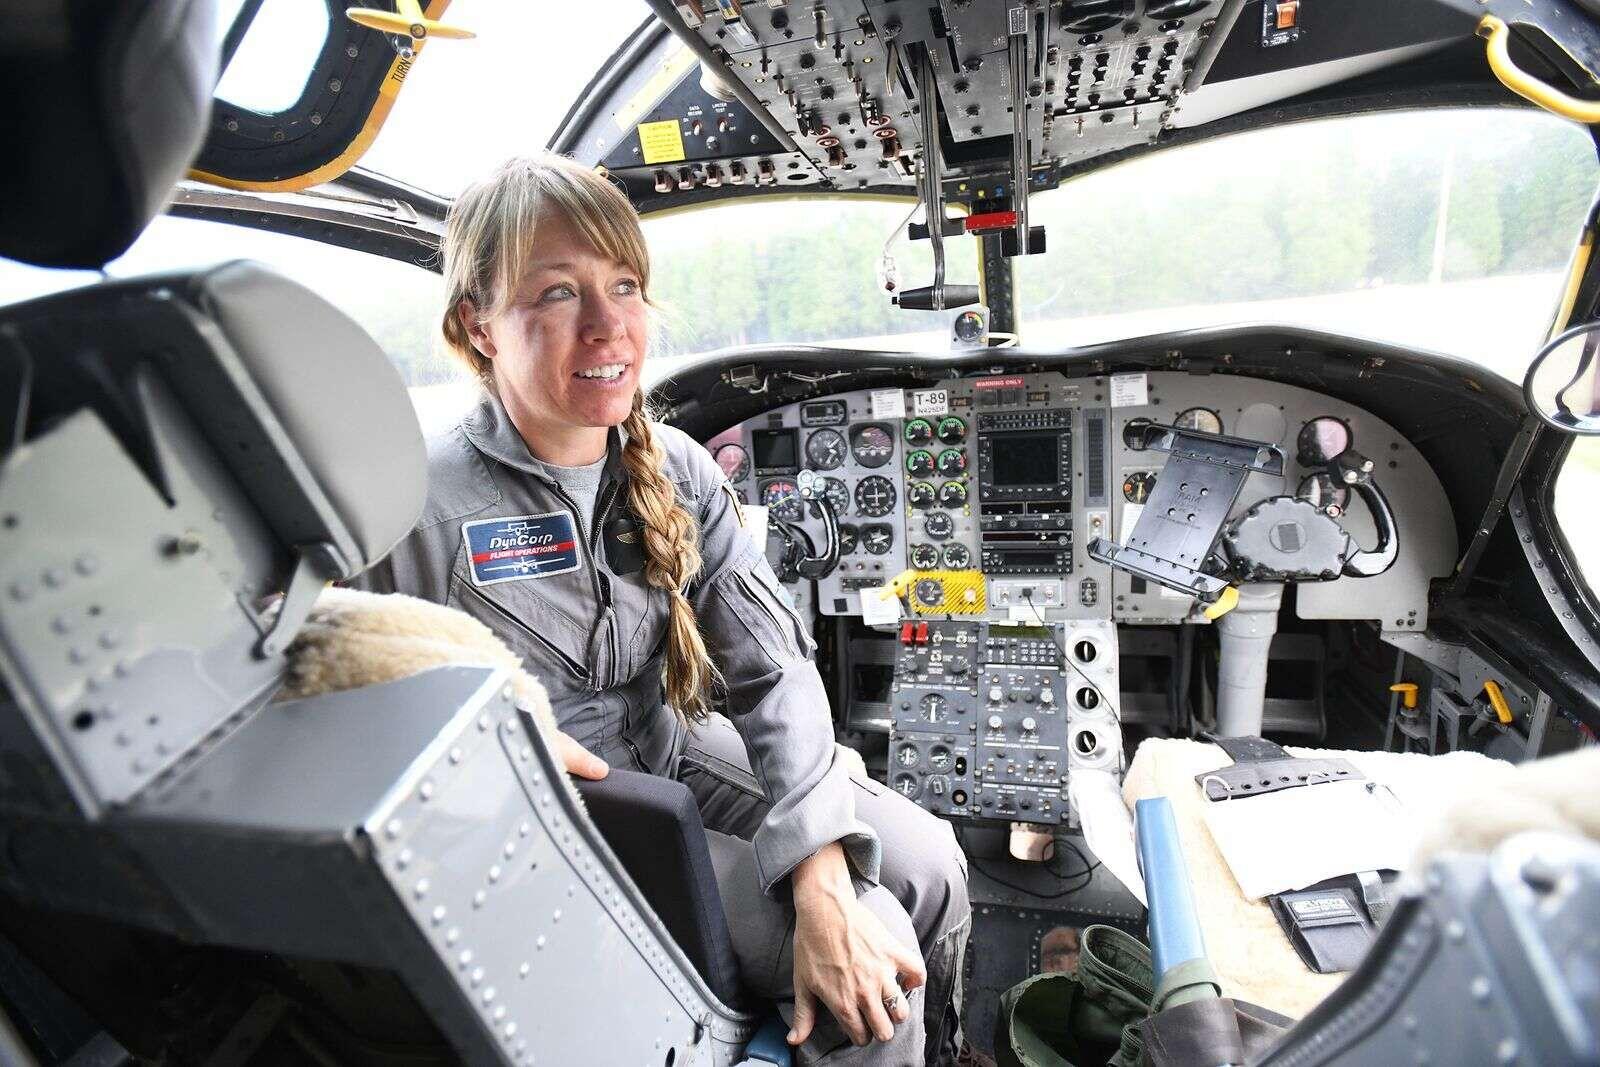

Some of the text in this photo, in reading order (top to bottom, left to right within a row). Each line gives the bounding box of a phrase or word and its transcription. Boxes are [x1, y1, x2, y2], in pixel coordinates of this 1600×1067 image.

[391, 58, 412, 82] TURN
[916, 392, 945, 405] T-89
[489, 534, 553, 550] DynCorp
[490, 545, 558, 560] FLIGHT OPERATIONS
